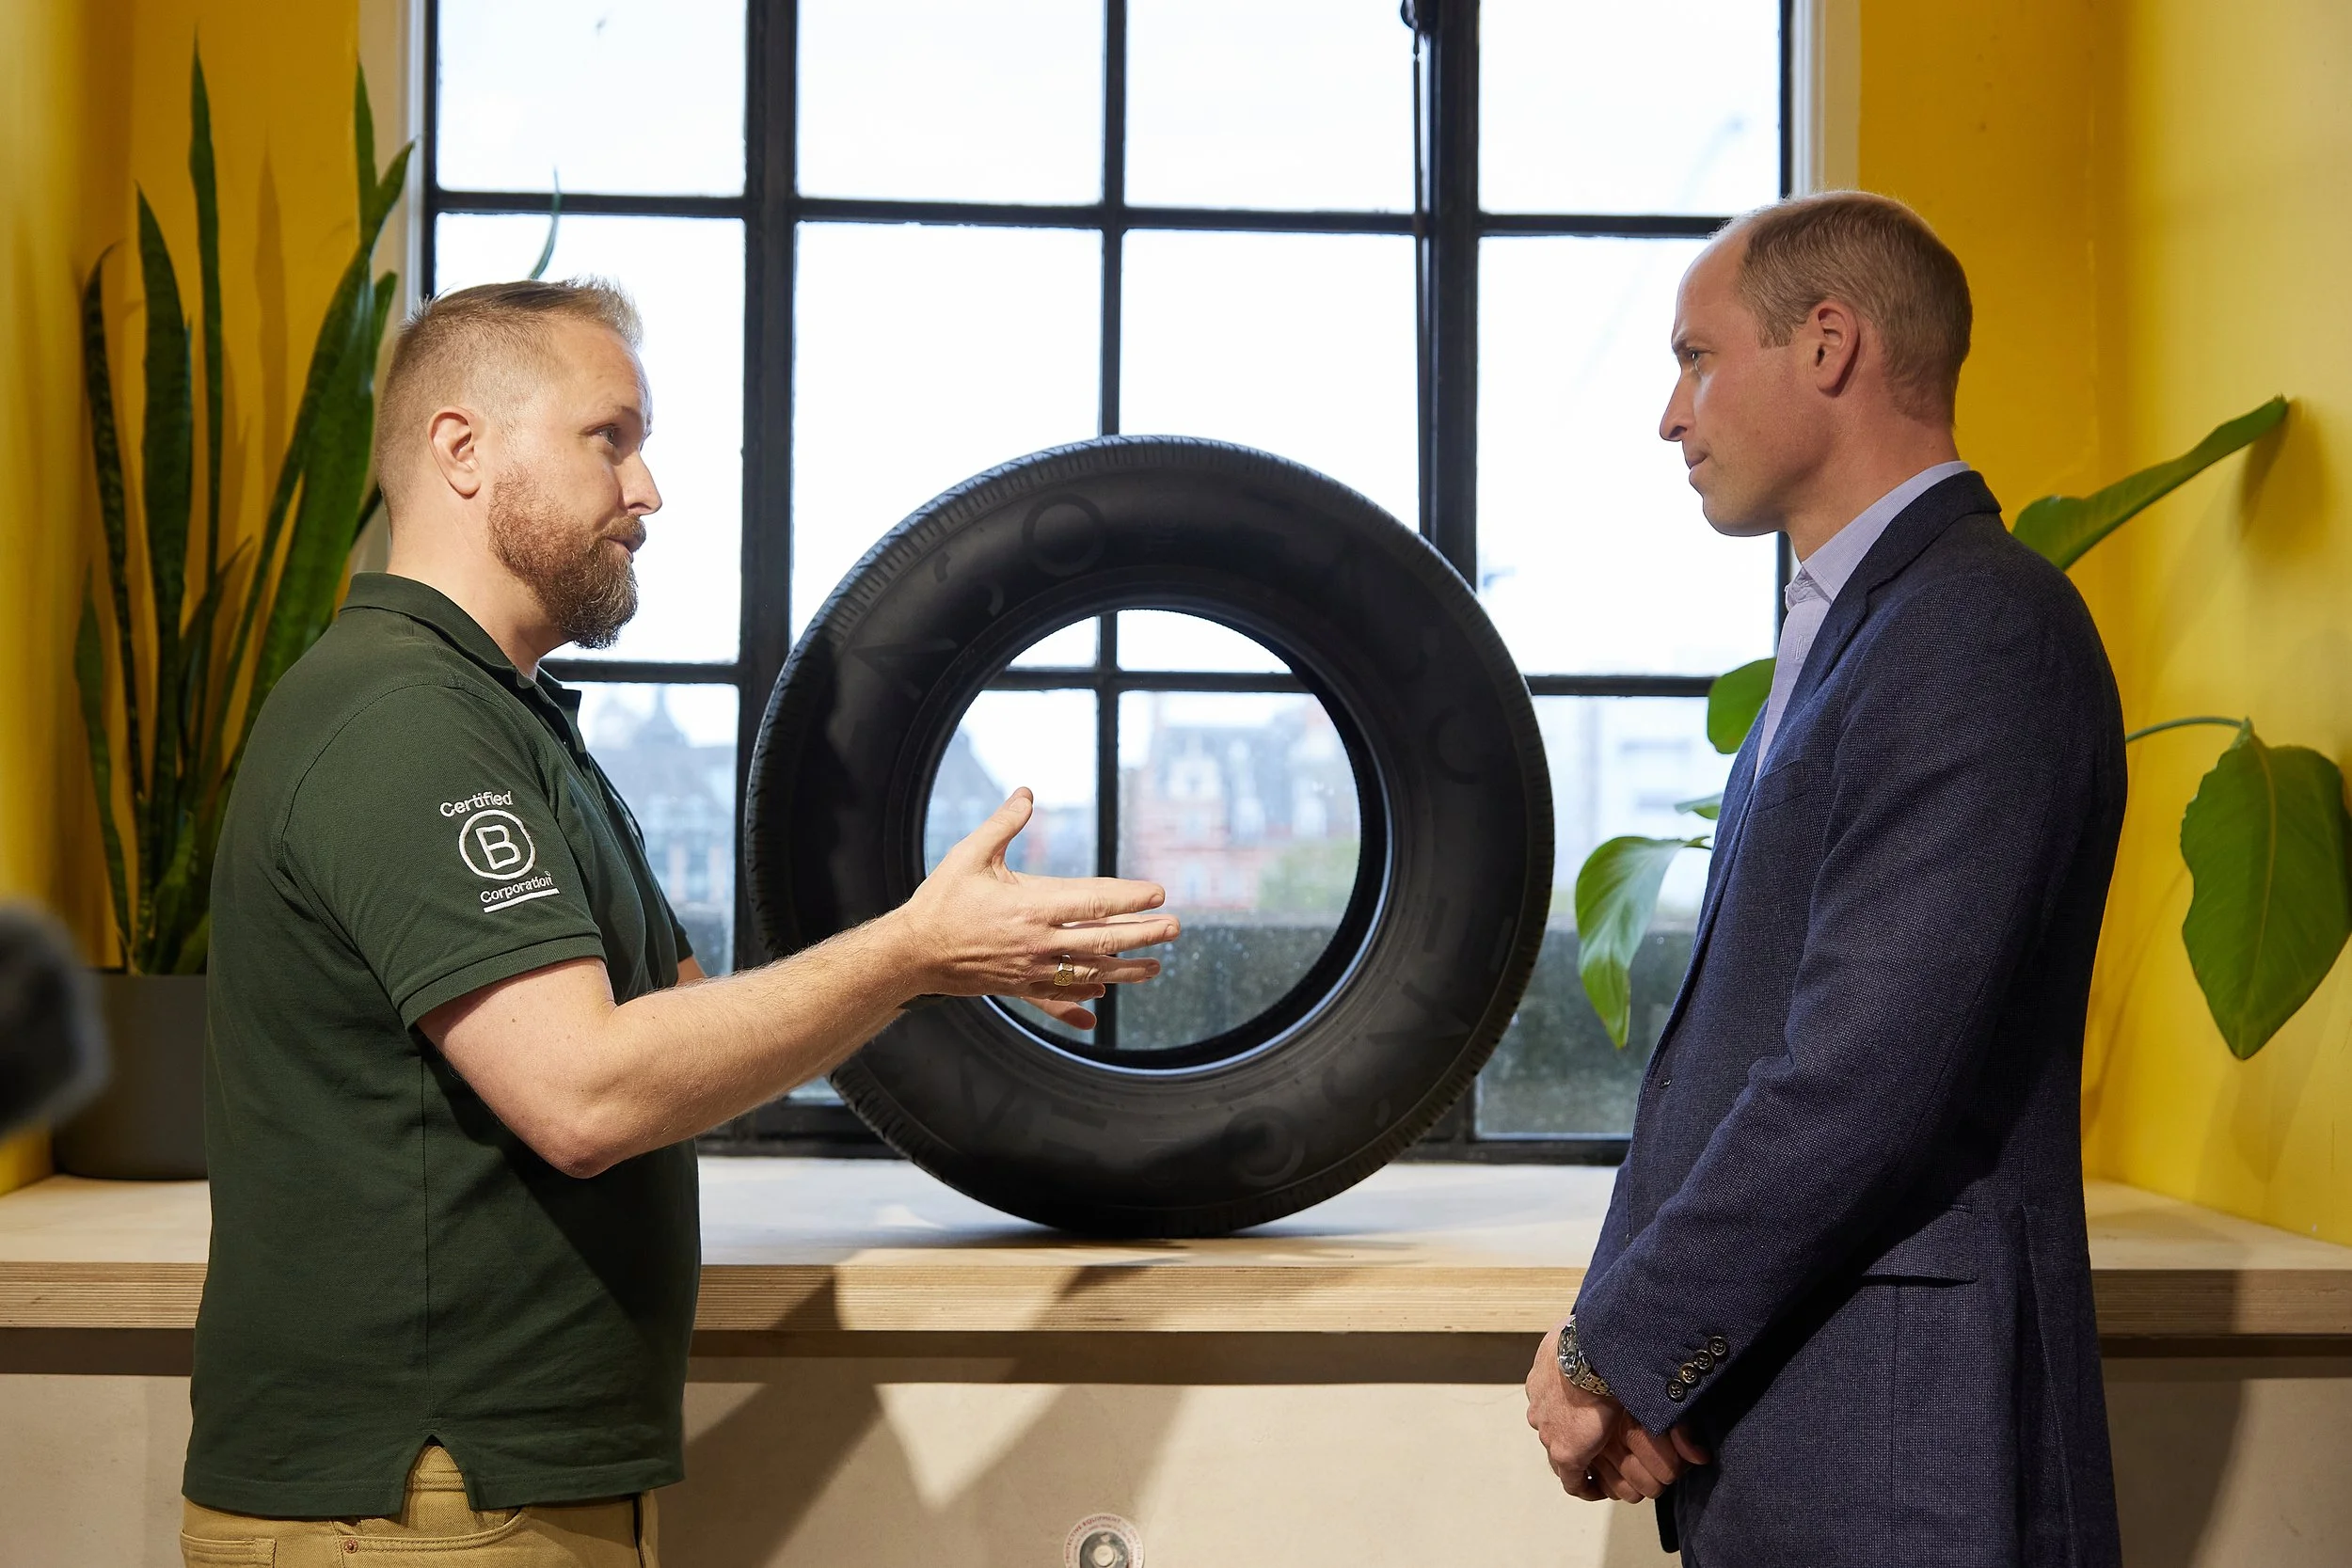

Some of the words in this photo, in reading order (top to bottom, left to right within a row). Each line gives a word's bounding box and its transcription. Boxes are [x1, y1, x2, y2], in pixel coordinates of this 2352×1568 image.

[439, 791, 513, 817] Certified
[475, 824, 520, 870] B
[480, 875, 553, 903] Corporation
